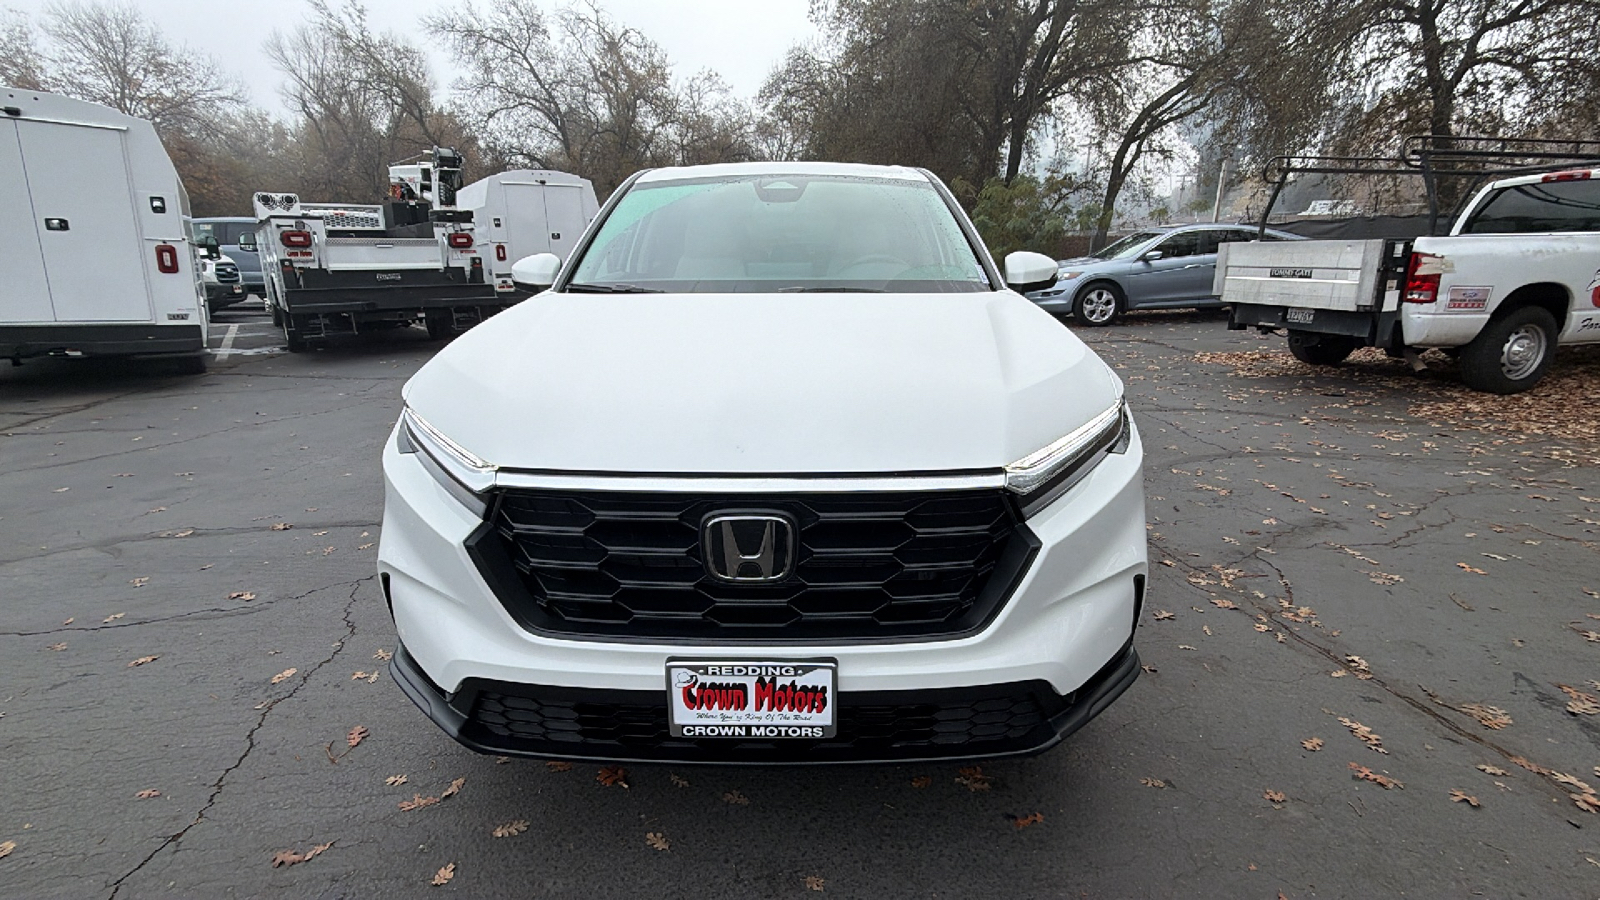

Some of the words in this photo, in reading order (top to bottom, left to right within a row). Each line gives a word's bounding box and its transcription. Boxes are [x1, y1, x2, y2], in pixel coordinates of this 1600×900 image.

[708, 666, 795, 676] REDDING
[682, 674, 749, 711] Crown
[755, 676, 828, 714] Motors
[744, 713, 762, 722] King
[765, 713, 775, 722] Of
[682, 726, 746, 737] CROWN
[751, 727, 823, 737] MOTORS
